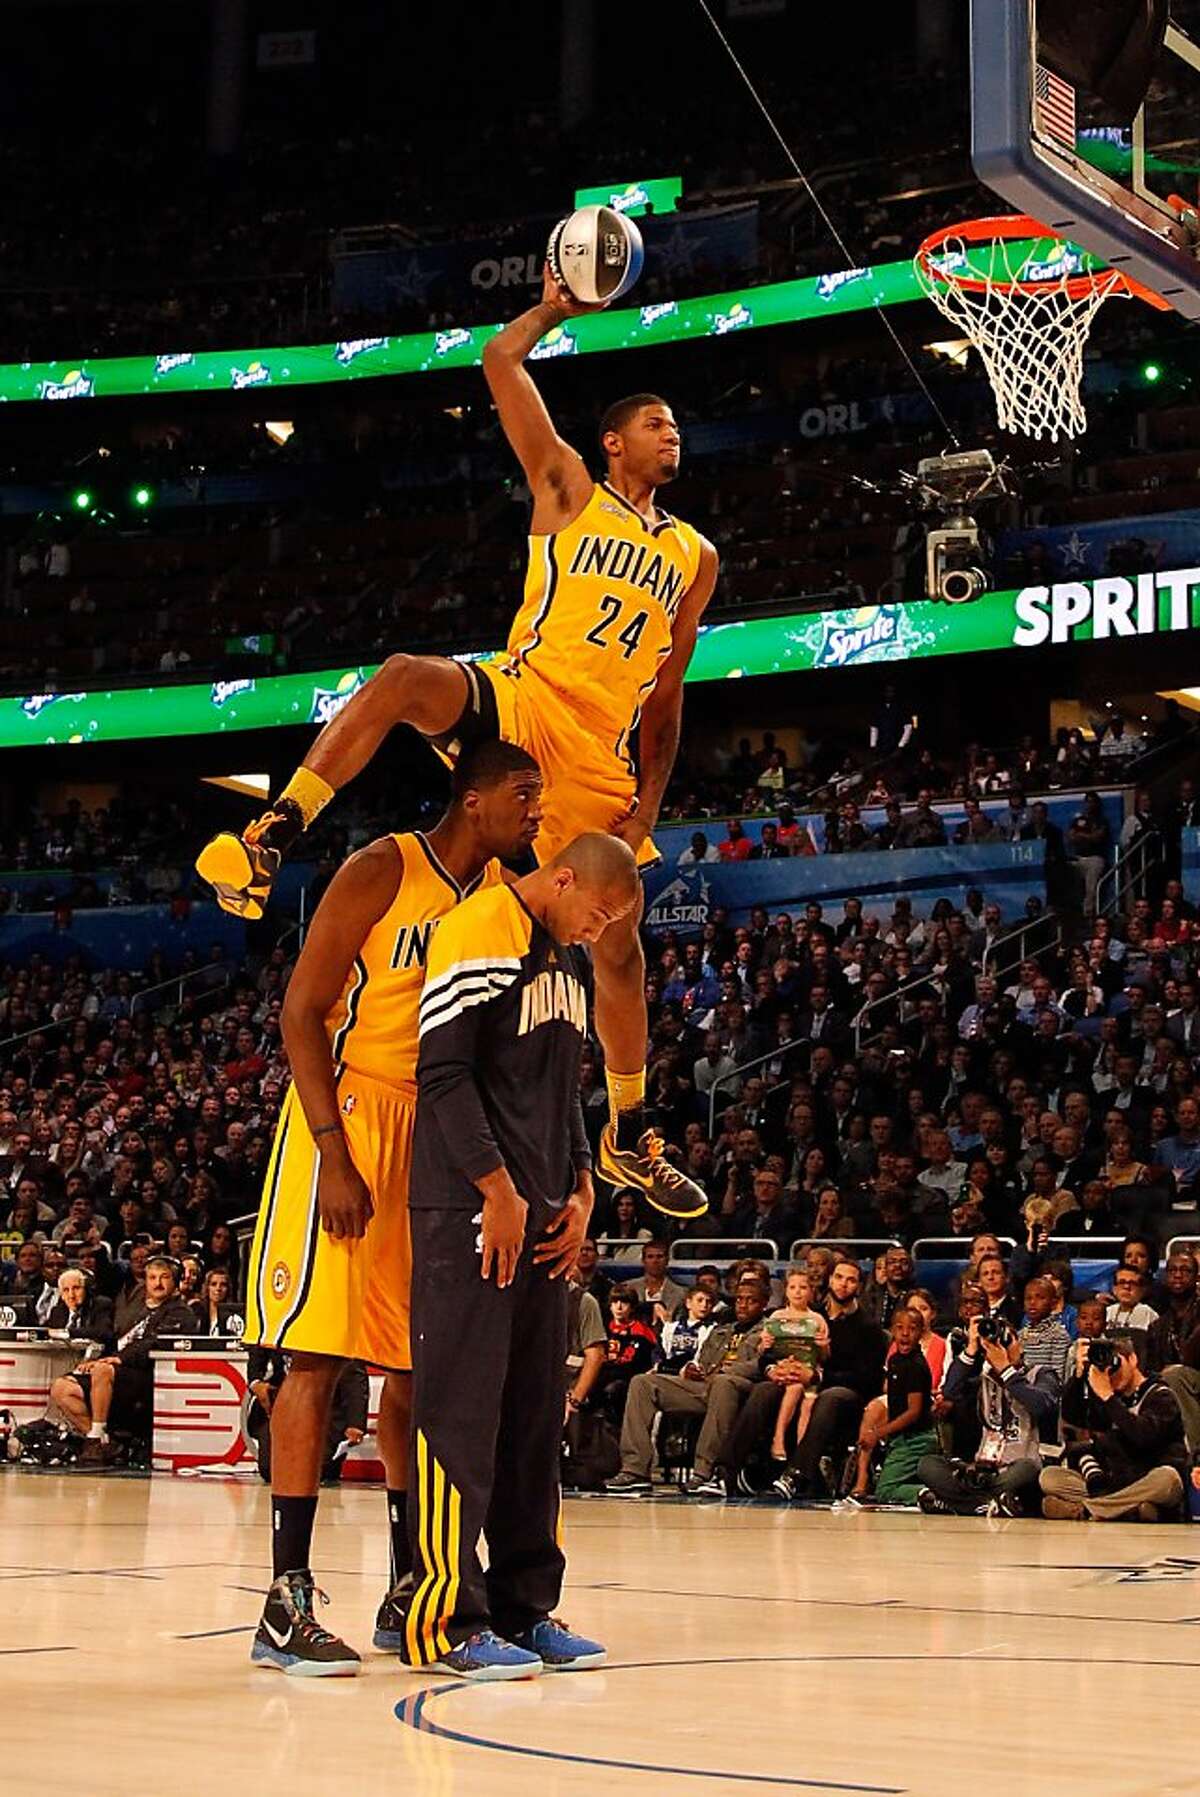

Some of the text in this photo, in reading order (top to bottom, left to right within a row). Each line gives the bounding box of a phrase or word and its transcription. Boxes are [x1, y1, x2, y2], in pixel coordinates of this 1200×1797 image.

[800, 401, 867, 438] ORL
[584, 594, 650, 661] 24
[1013, 568, 1200, 646] SPRIT
[824, 613, 895, 664] Sprite
